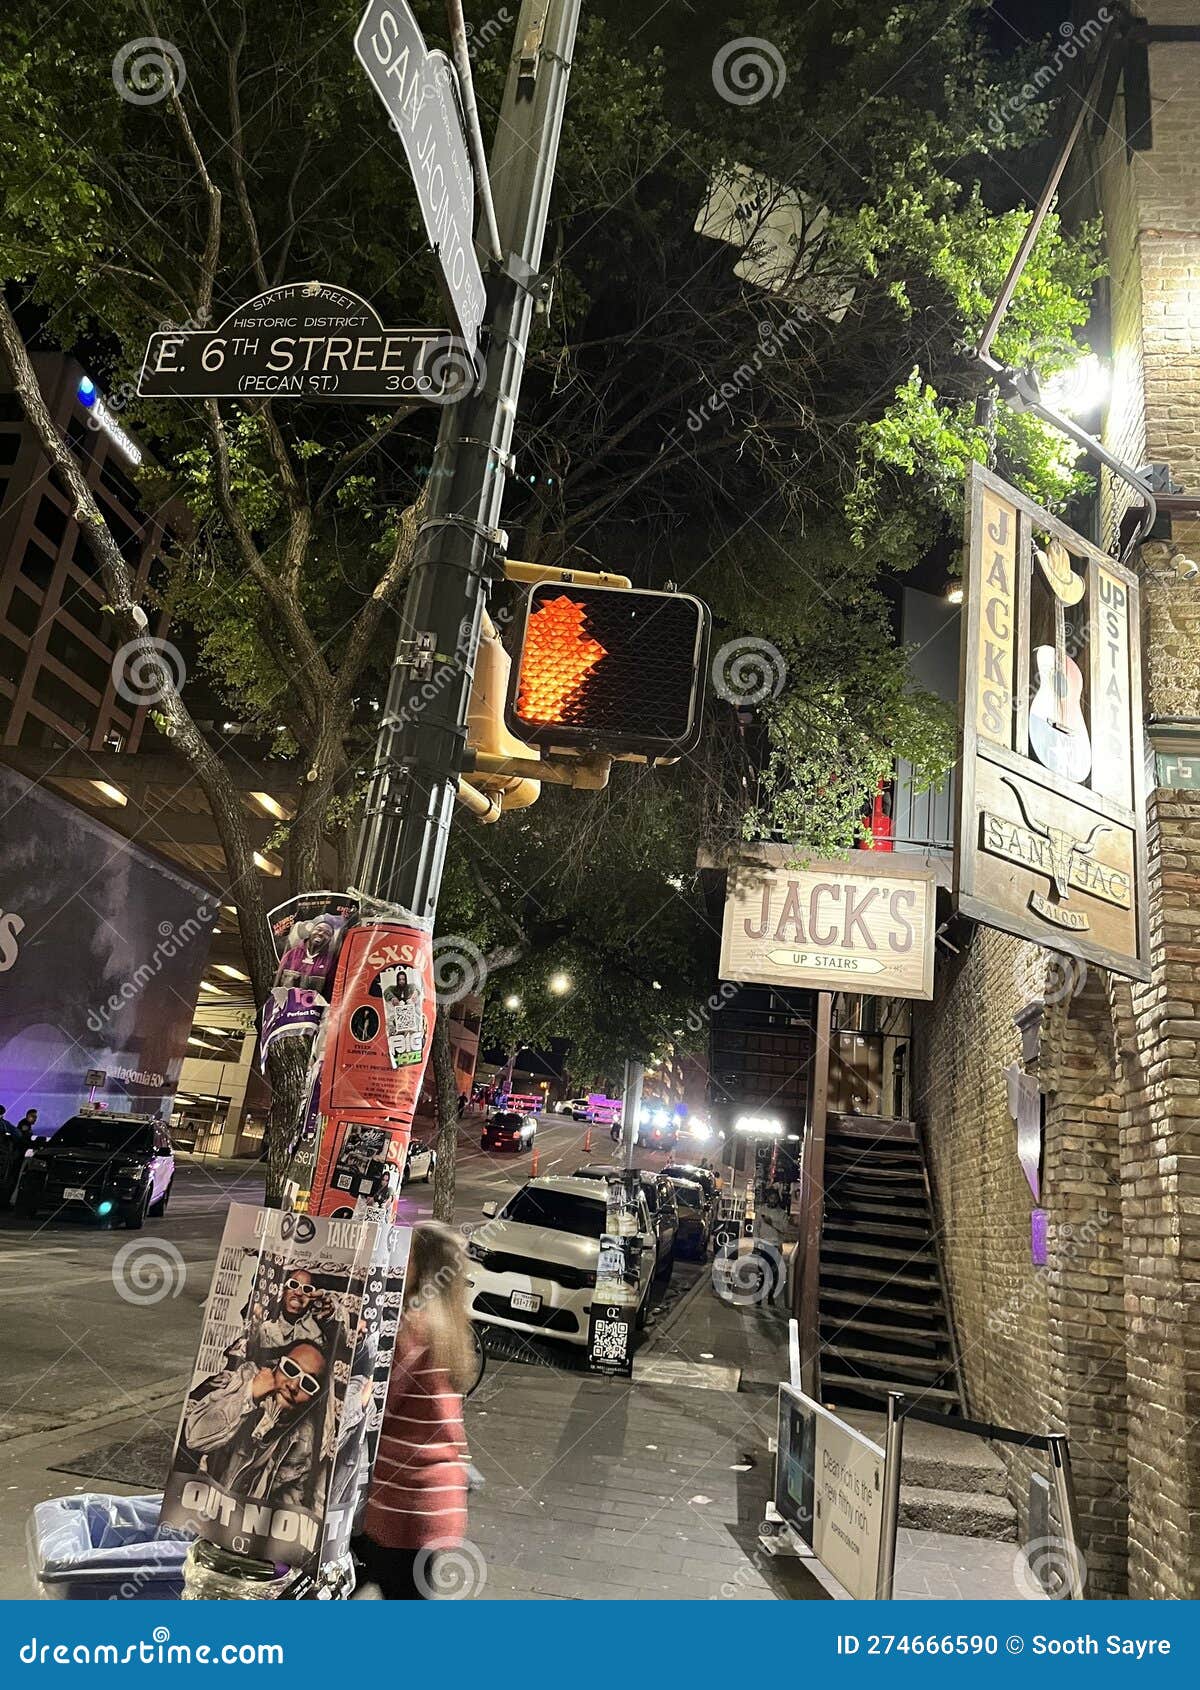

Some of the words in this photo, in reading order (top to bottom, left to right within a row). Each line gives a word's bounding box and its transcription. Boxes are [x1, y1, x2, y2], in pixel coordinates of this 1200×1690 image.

[371, 10, 425, 133] SAN
[416, 123, 467, 291] JACINTO
[252, 288, 295, 311] SIXTH
[301, 287, 357, 311] STREET
[233, 317, 298, 328] HISTORIC
[304, 316, 369, 328] DISTRICT
[154, 339, 187, 373] E.
[201, 338, 260, 373] 6TH
[266, 337, 439, 372] STREET
[237, 374, 303, 391] (PECAN
[310, 374, 340, 391] ST.)
[385, 375, 433, 391] 300
[1099, 575, 1126, 610] UP
[989, 817, 1051, 868] SAN
[1075, 858, 1128, 900] JAC
[744, 878, 916, 953] JACK'S
[1035, 896, 1086, 928] SALOON
[793, 954, 808, 965] UP
[815, 956, 859, 970] STAIRS
[209, 1297, 230, 1321] FOR
[606, 1307, 620, 1319] QC
[181, 1480, 237, 1527] OUT
[242, 1503, 319, 1554] NOW
